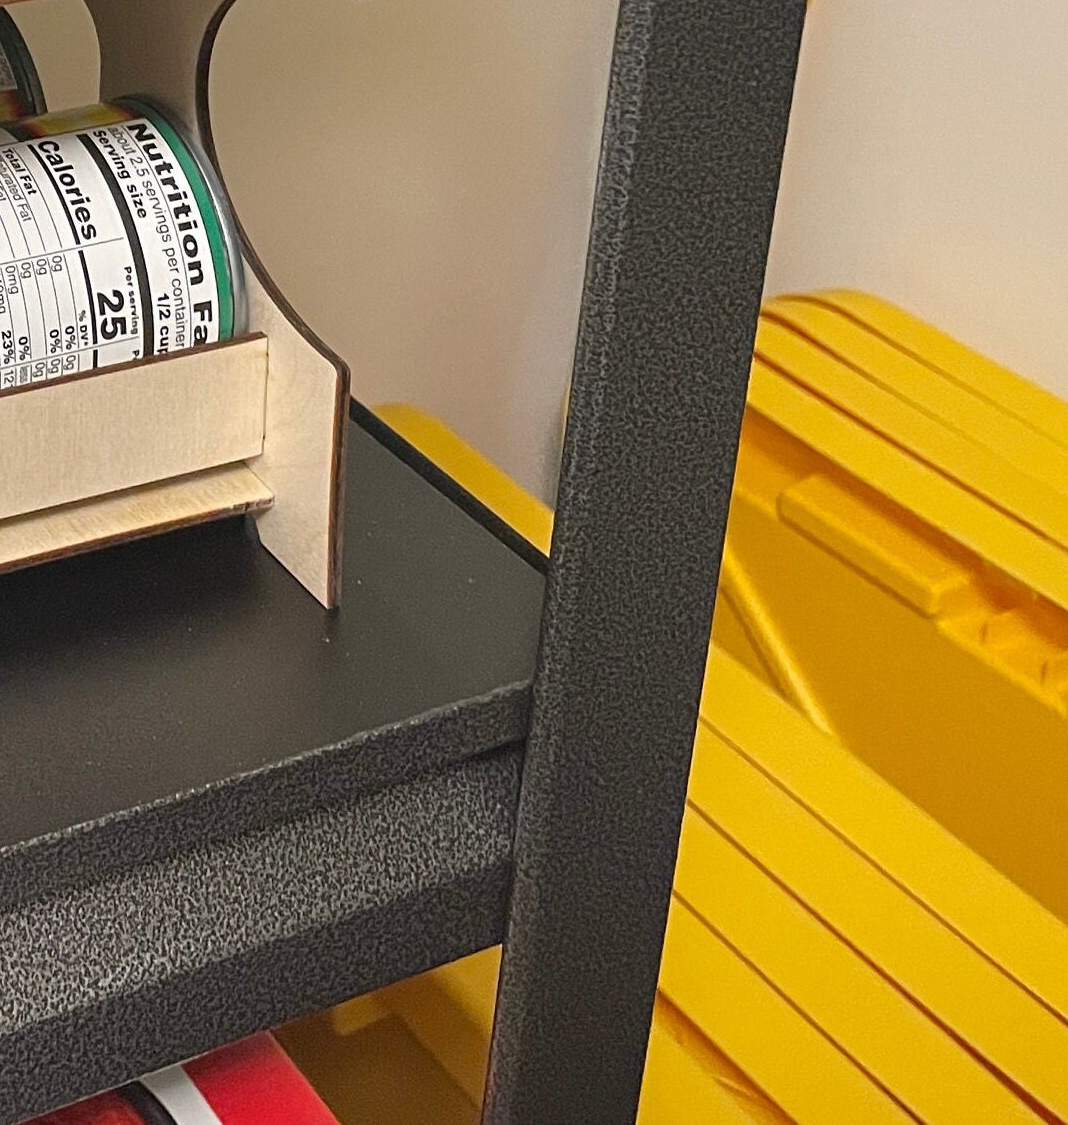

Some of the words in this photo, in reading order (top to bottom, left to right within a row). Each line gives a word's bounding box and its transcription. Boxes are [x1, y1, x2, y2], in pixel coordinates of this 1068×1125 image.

[107, 126, 136, 155] about
[2, 148, 26, 173] Total
[129, 156, 149, 178] 2.5
[19, 174, 37, 195] Fat
[16, 203, 32, 222] Fat
[127, 124, 204, 286] Nutrition
[142, 179, 172, 243] servings
[92, 130, 131, 180] Serving
[126, 183, 147, 219] size
[157, 292, 172, 319] 1/2
[37, 140, 97, 241] Calories
[96, 288, 127, 341] 25
[36, 258, 48, 276] 0g
[51, 255, 63, 272] 0g
[162, 247, 181, 274] per
[5, 265, 19, 295] 0mg
[18, 336, 31, 361] 0%
[20, 262, 32, 279] 0g
[32, 362, 45, 378] 0g
[129, 289, 140, 335] serving
[171, 277, 185, 347] container
[1, 330, 16, 365] 23%
[49, 329, 62, 354] 0%
[64, 325, 77, 350] 0%
[47, 358, 61, 374] 0g
[63, 354, 76, 370] 0g
[2, 369, 15, 387] 12
